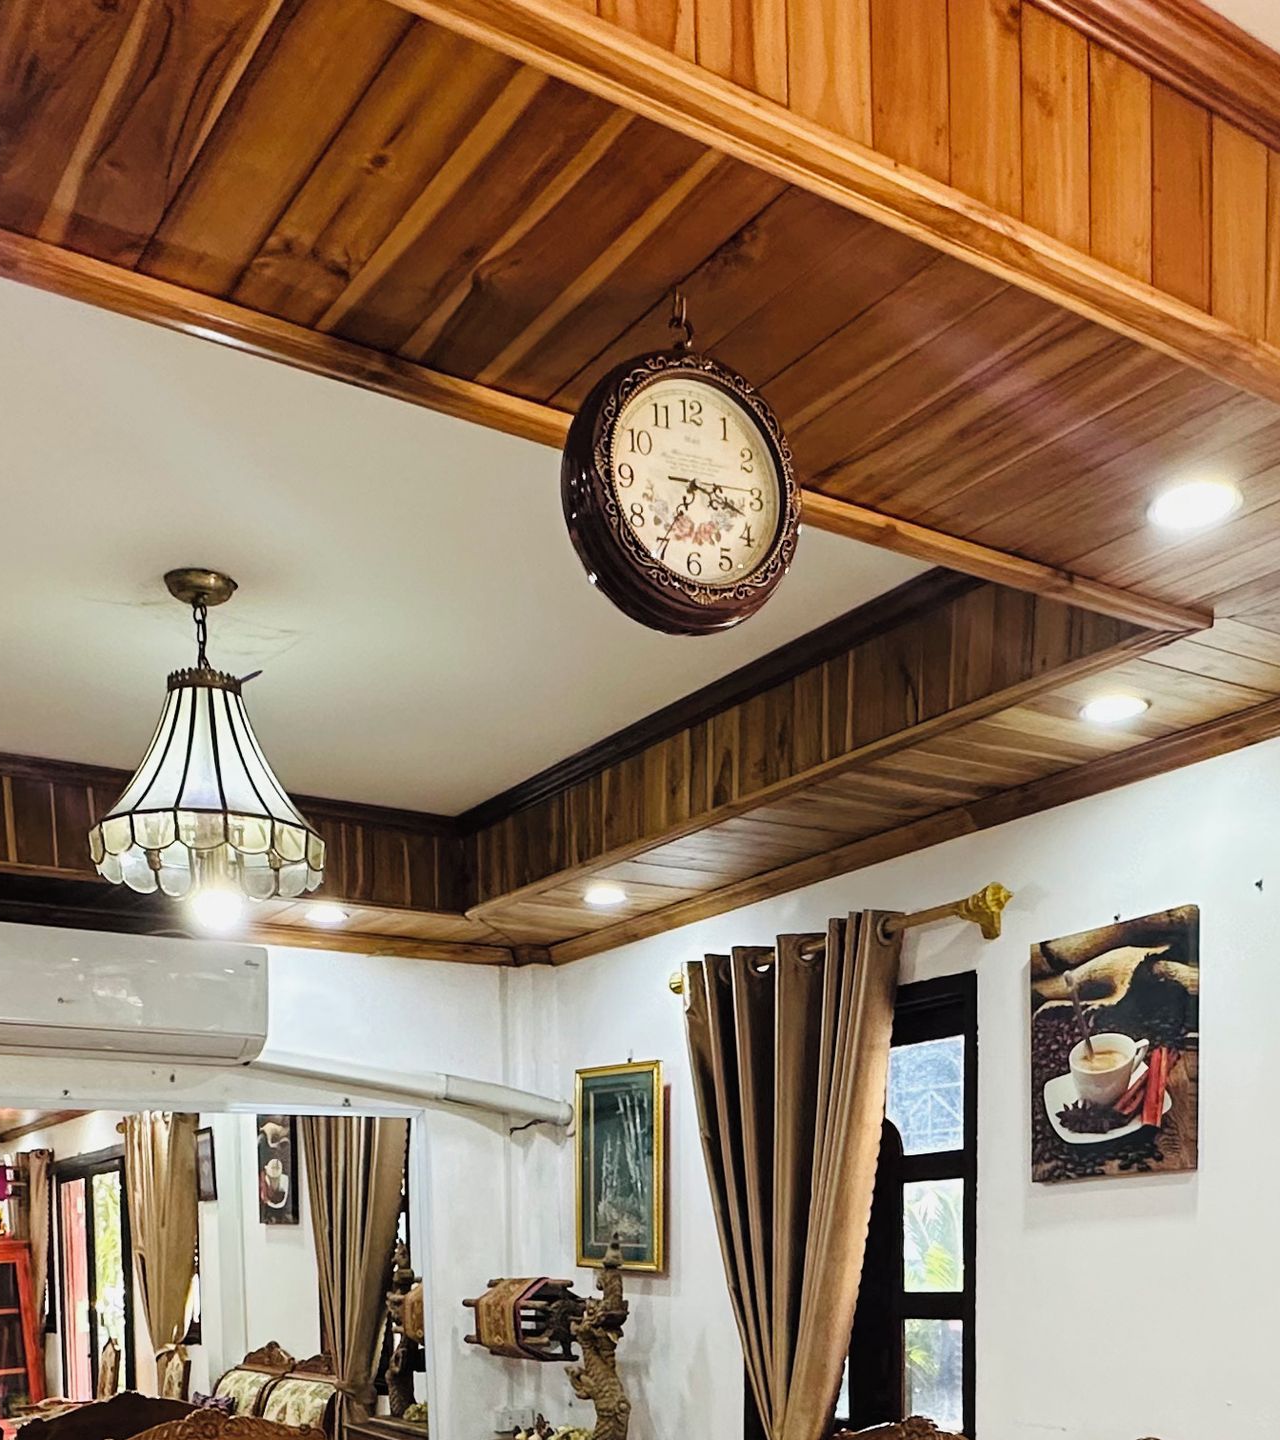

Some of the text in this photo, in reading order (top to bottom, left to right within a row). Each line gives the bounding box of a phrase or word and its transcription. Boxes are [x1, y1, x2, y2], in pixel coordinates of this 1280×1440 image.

[653, 402, 671, 429] 11
[678, 399, 703, 426] 12
[720, 417, 730, 441] 1
[628, 428, 653, 456] 10
[741, 448, 754, 473] 2
[617, 463, 635, 488] 9
[750, 488, 764, 511] 3
[630, 503, 645, 528] 8
[740, 523, 755, 548] 4
[656, 537, 670, 560] 7
[719, 548, 733, 571] 5
[687, 552, 702, 576] 6
